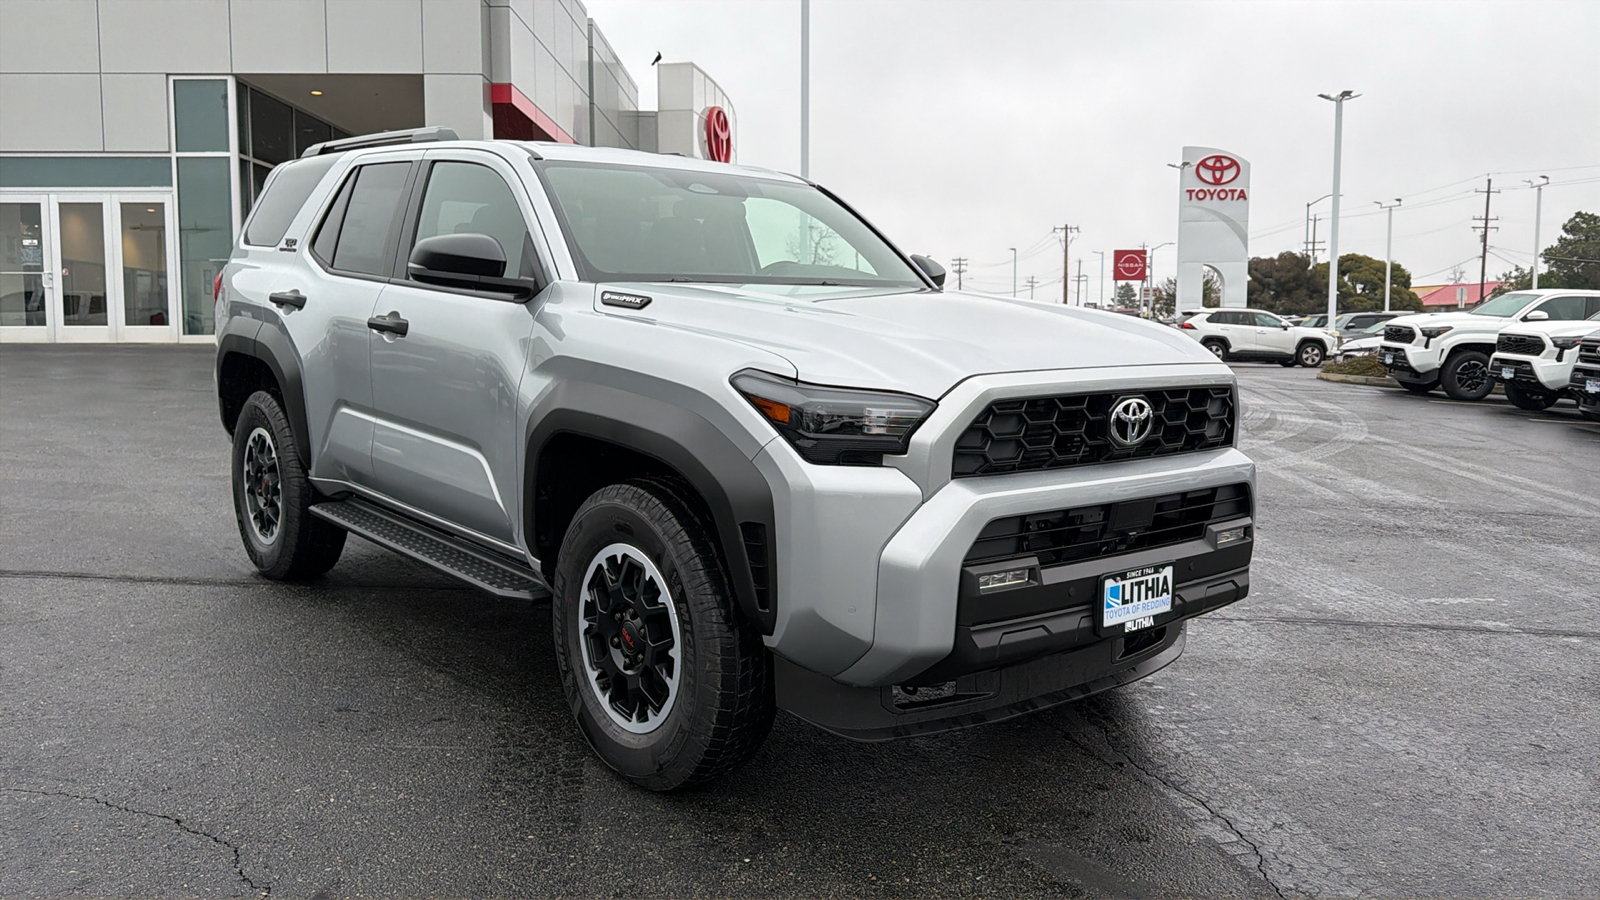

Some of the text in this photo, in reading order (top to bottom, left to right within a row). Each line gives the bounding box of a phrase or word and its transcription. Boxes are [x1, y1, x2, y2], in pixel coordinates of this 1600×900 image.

[1186, 188, 1247, 201] TOYOTA
[1126, 569, 1142, 579] SINCE
[1122, 575, 1170, 605] LITHIA
[1105, 597, 1170, 620] TOYOTA OF REDDING
[1131, 615, 1155, 630] LITHIA
